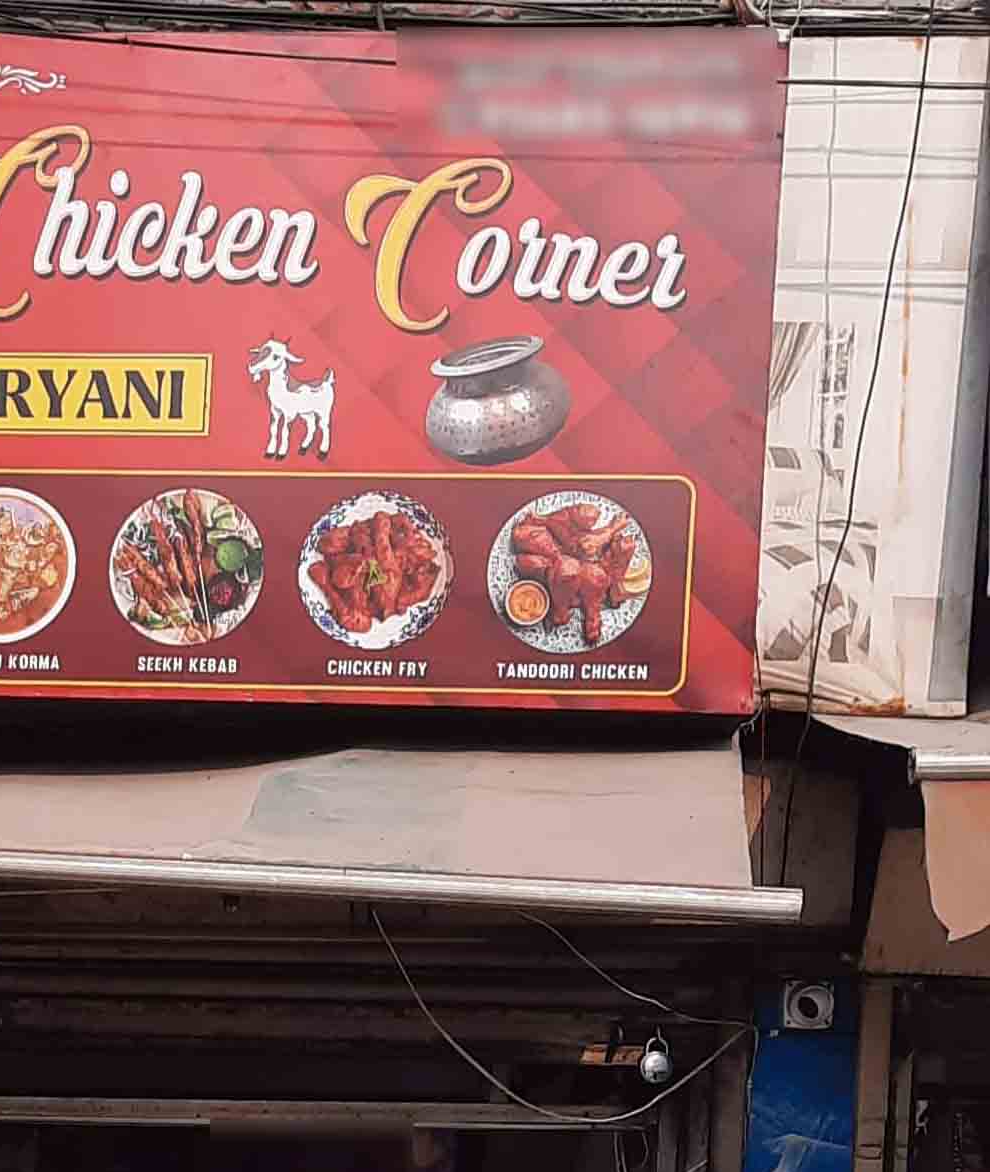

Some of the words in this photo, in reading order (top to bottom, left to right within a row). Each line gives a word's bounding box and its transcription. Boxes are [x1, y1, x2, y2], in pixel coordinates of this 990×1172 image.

[344, 157, 687, 332] Corner
[8, 654, 59, 670] KORMA
[137, 656, 183, 672] SEEKH
[188, 657, 237, 673] KEBAB
[327, 660, 393, 676] CHICKEN
[398, 661, 428, 677] FRY
[496, 662, 575, 679] TANDOORI
[581, 663, 648, 680] CHICKEN
